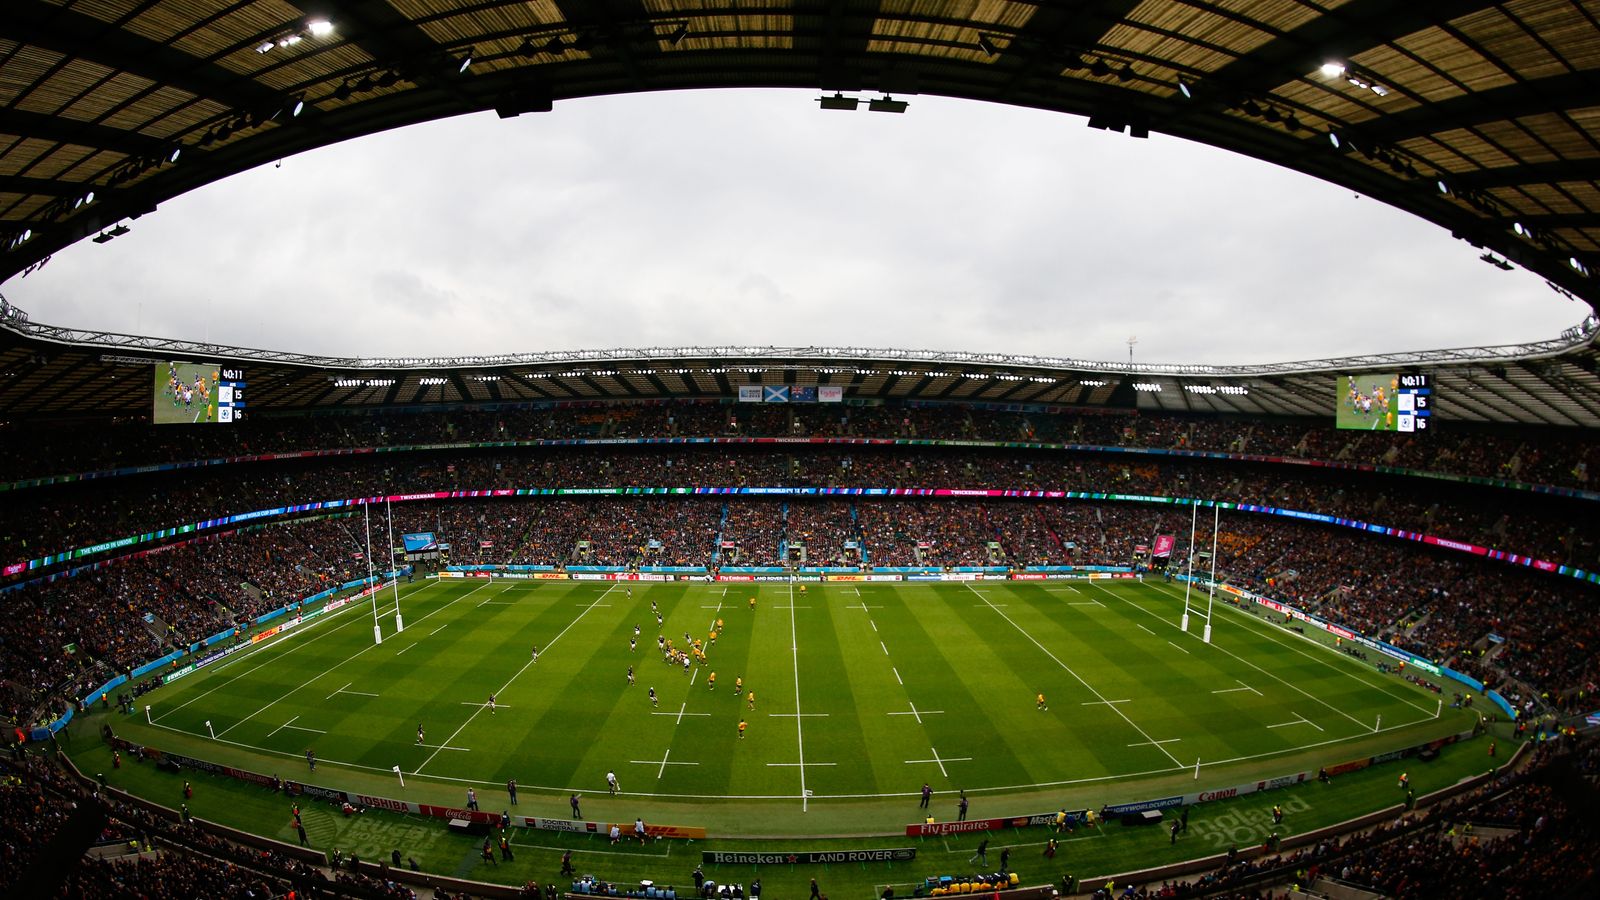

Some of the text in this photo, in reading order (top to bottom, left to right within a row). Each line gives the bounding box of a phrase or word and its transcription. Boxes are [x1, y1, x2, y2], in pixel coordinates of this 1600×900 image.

[223, 369, 242, 379] 40:11
[1402, 375, 1425, 386] 40:11
[235, 390, 242, 399] 15
[1416, 397, 1426, 407] 15
[234, 410, 242, 419] 16
[1416, 418, 1426, 429] 16
[81, 548, 92, 556] THE
[92, 543, 110, 552] WORLD
[117, 538, 132, 546] UNION
[1436, 538, 1472, 552] TWICKENHAM
[303, 785, 341, 800] MasterCard
[1199, 788, 1237, 801] Canon
[357, 794, 410, 812] TOSHIBA
[541, 819, 573, 827] SOCIETE
[1030, 811, 1082, 826] Masted
[920, 820, 990, 836] Fly Emirates
[714, 852, 784, 864] Heineken
[809, 852, 846, 863] LAND
[848, 850, 893, 861] ROVER
